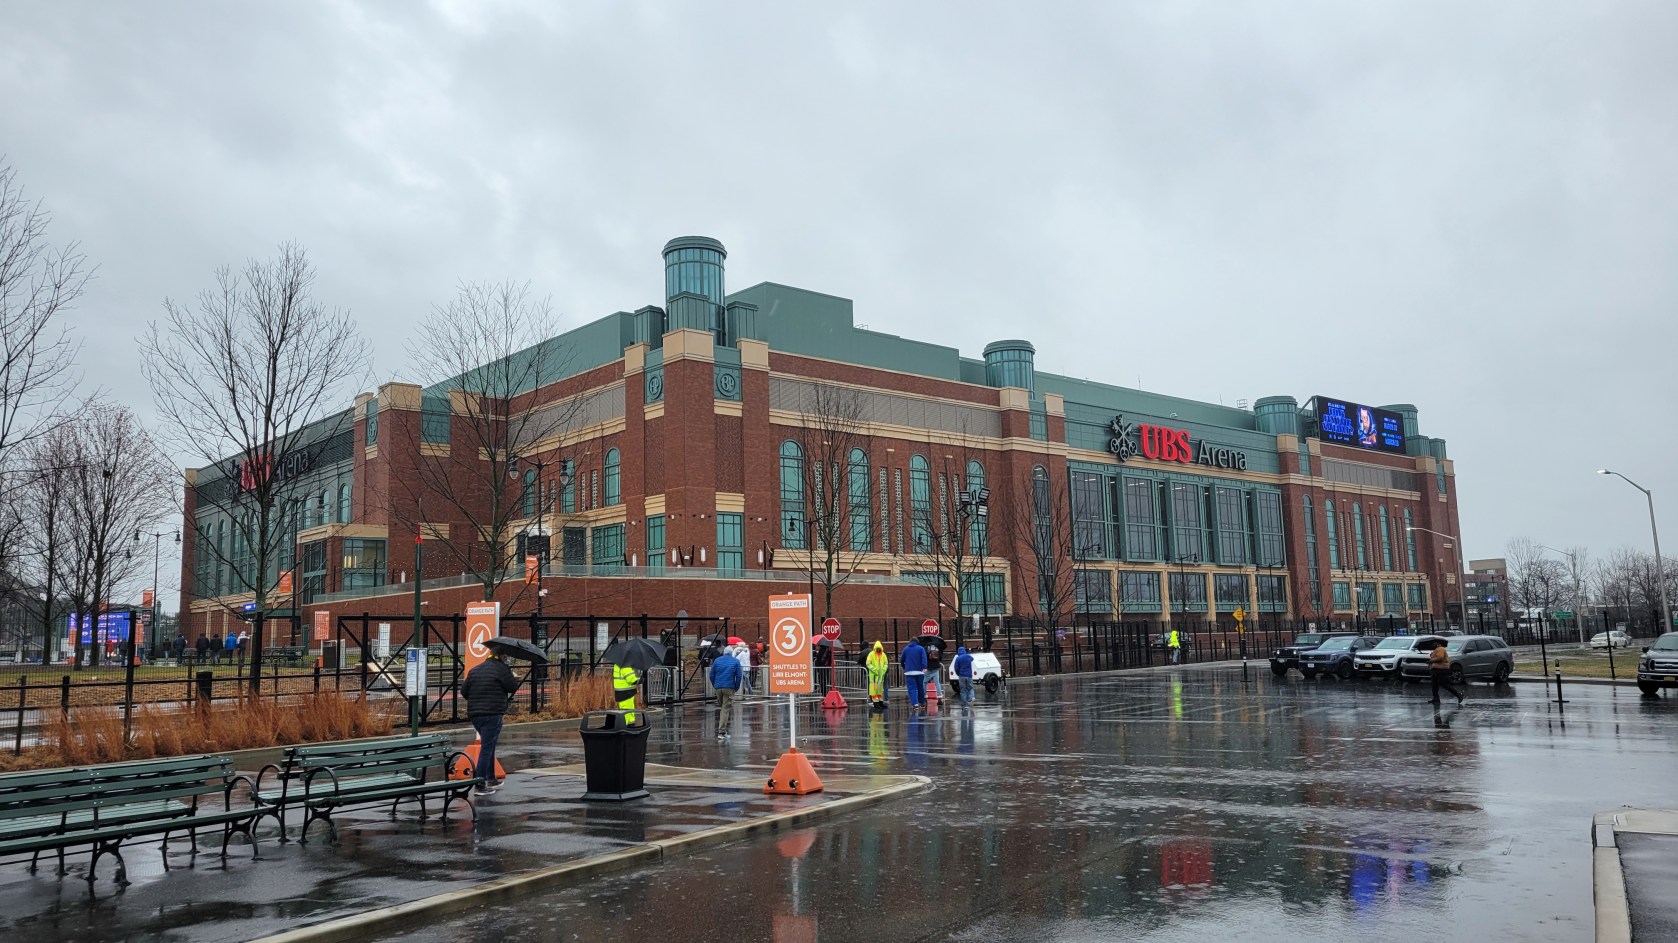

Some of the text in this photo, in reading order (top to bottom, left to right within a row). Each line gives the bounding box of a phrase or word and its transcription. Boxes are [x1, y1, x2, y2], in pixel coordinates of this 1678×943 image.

[1138, 424, 1248, 470] UBS Arena
[472, 629, 485, 651] 4
[781, 625, 797, 650] 3
[823, 624, 840, 635] STOP
[923, 625, 938, 635] STOP
